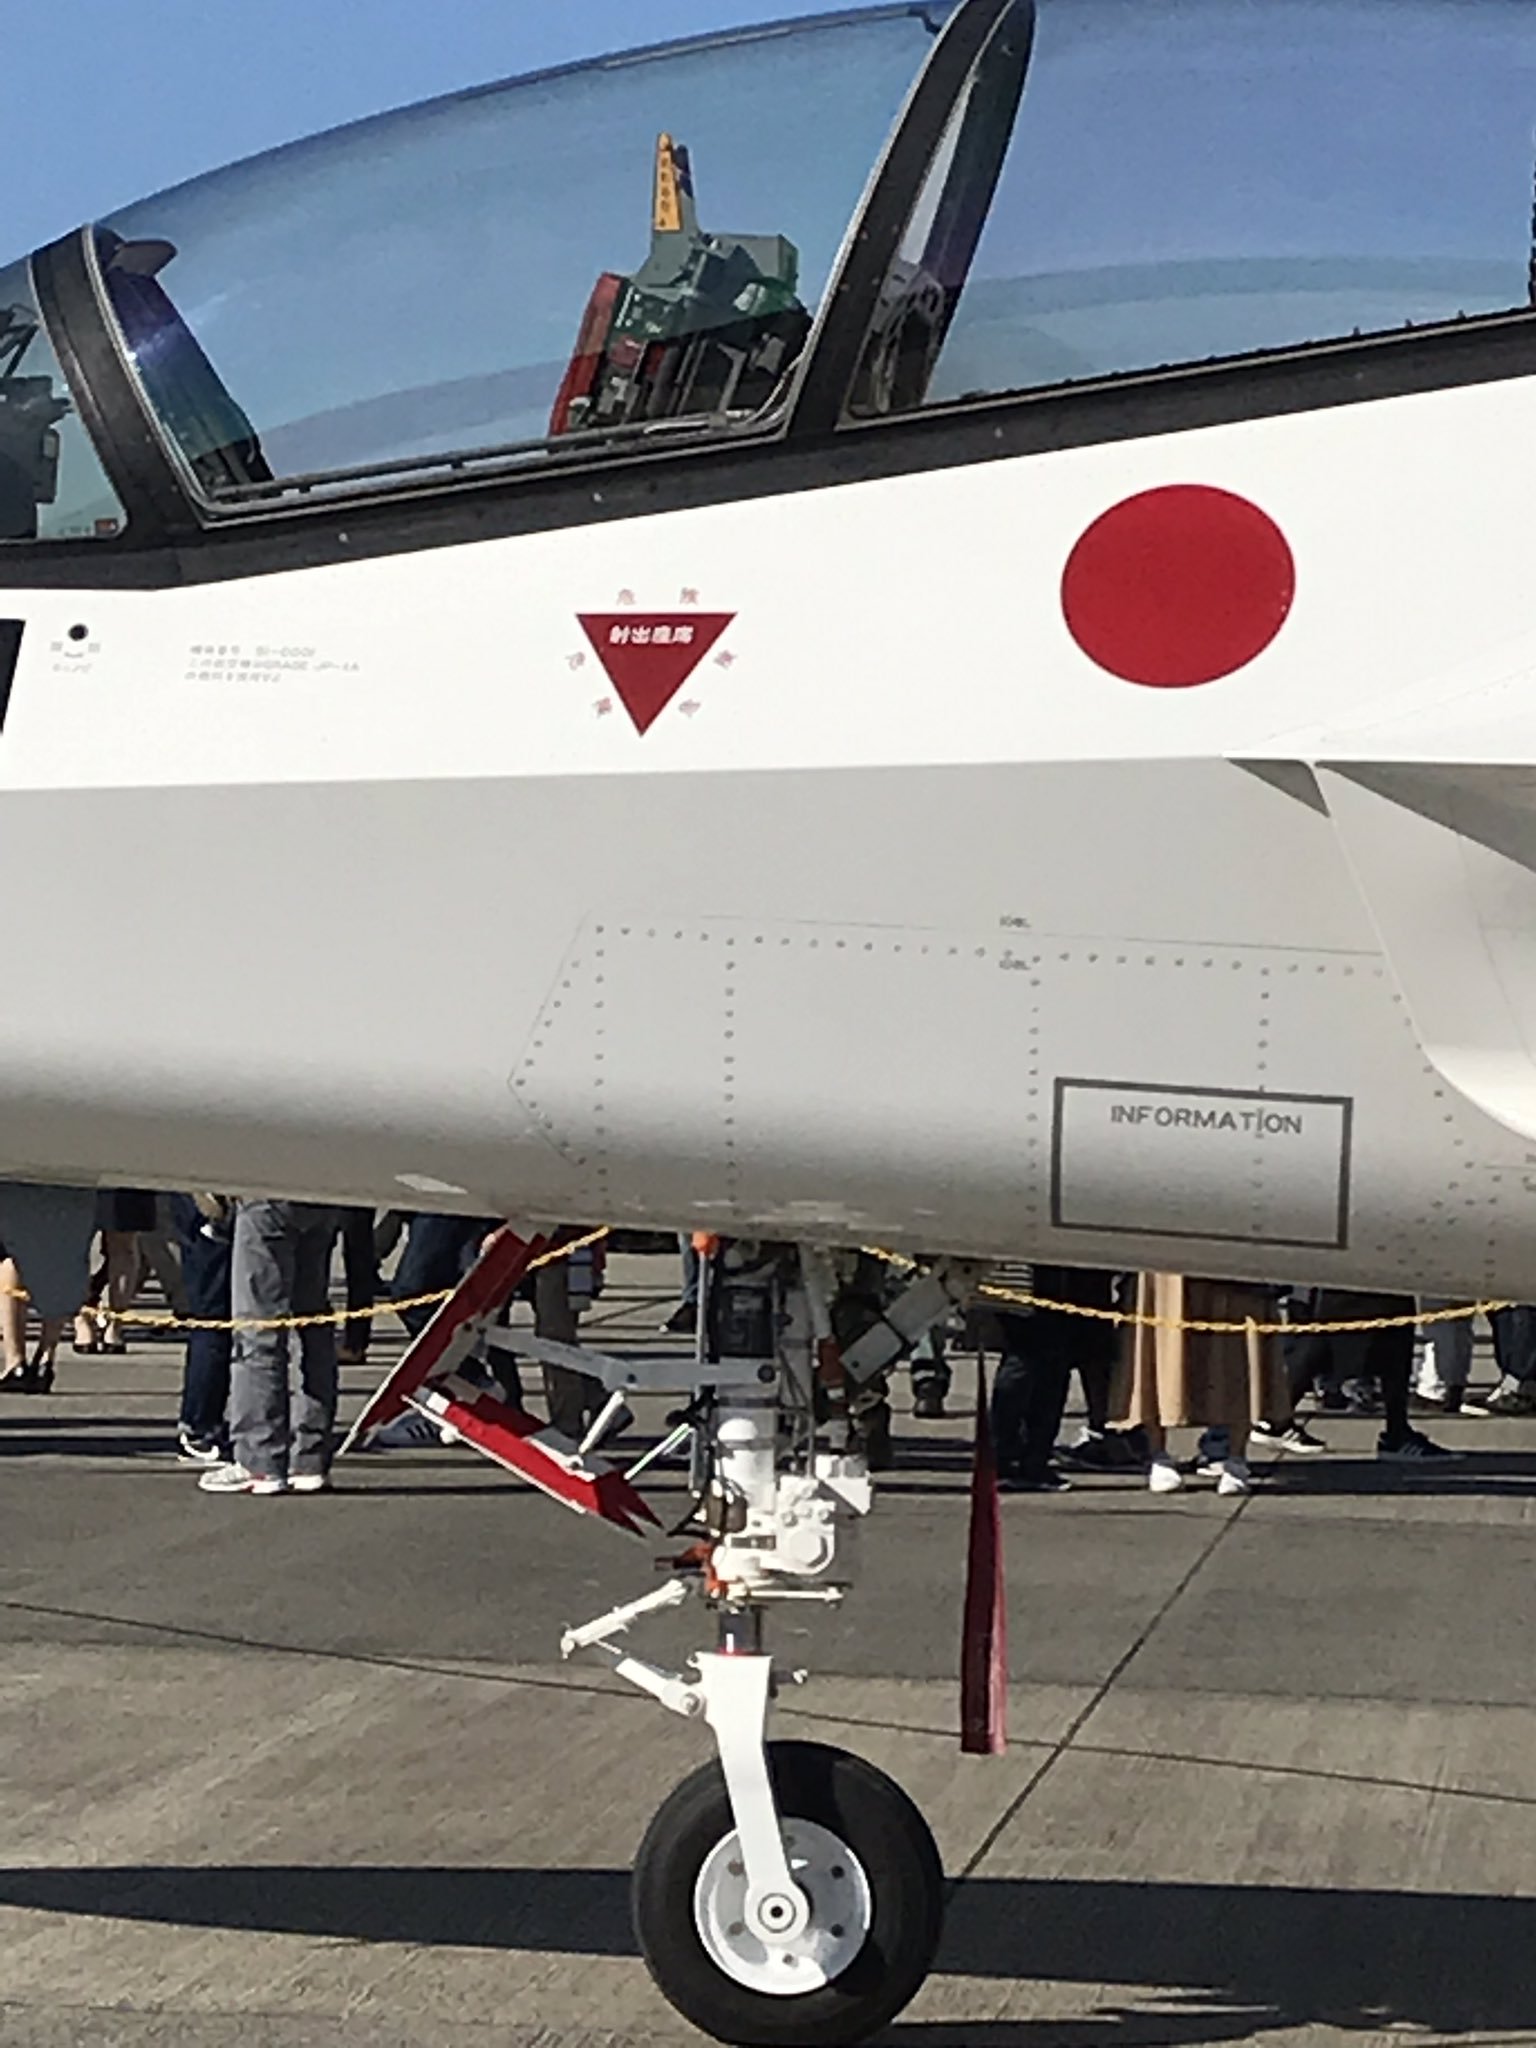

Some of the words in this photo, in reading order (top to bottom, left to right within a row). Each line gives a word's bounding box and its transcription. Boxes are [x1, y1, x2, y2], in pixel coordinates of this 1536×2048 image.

[609, 625, 695, 644] 射出座席
[1110, 1104, 1303, 1134] INFORMATION
